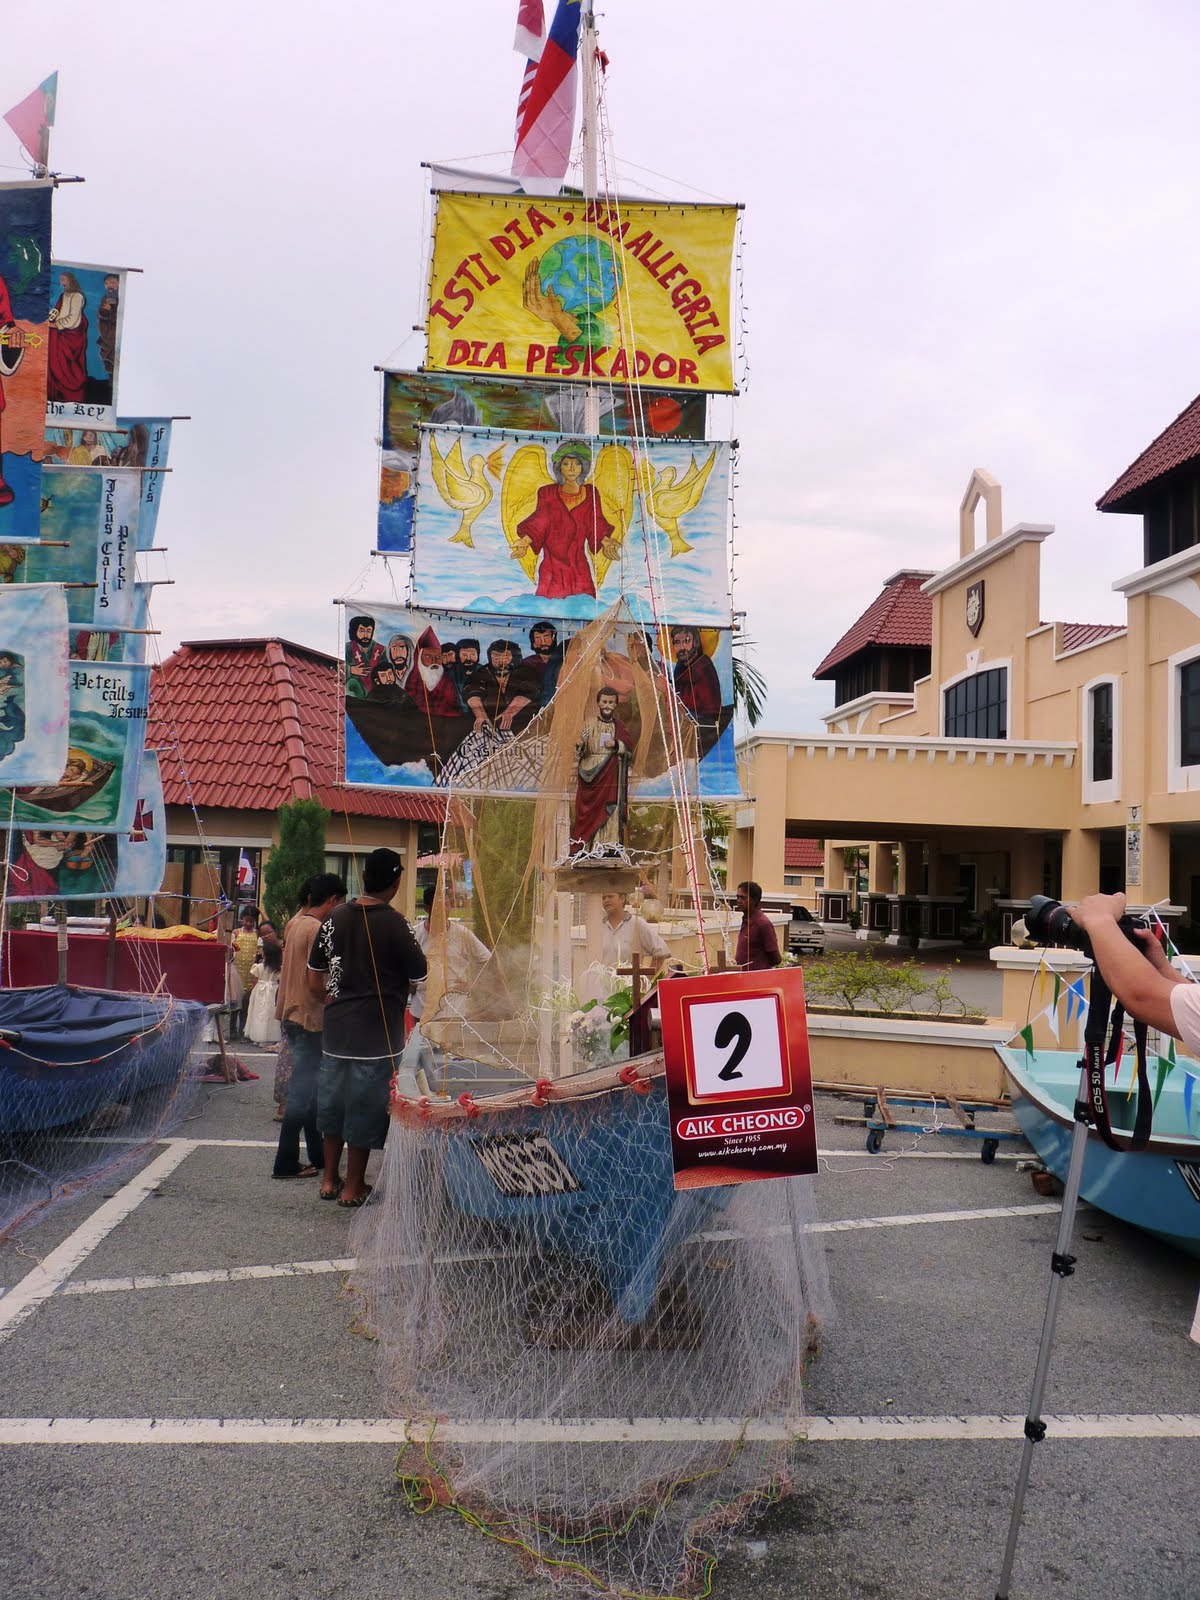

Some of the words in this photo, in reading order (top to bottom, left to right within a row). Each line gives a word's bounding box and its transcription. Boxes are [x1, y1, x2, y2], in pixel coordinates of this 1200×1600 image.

[430, 252, 500, 330] ISTI
[582, 201, 631, 243] DIA
[624, 230, 727, 356] ALLEGRIA
[446, 340, 508, 370] DIA
[526, 344, 699, 384] PESKADOR
[73, 403, 105, 421] Key
[105, 478, 118, 535] Jesus
[117, 525, 129, 590] Peter
[72, 671, 122, 690] Peter
[108, 704, 148, 719] Jesus
[457, 740, 523, 760] Castng
[714, 1012, 752, 1081] 2
[1091, 1071, 1101, 1085] 5D
[1093, 1087, 1104, 1113] EOS
[685, 1119, 716, 1136] AIK
[721, 1111, 798, 1132] CHEONG
[698, 1143, 788, 1158] www.aikcheong.com.my
[724, 1137, 743, 1145] Since
[745, 1134, 761, 1143] 1955
